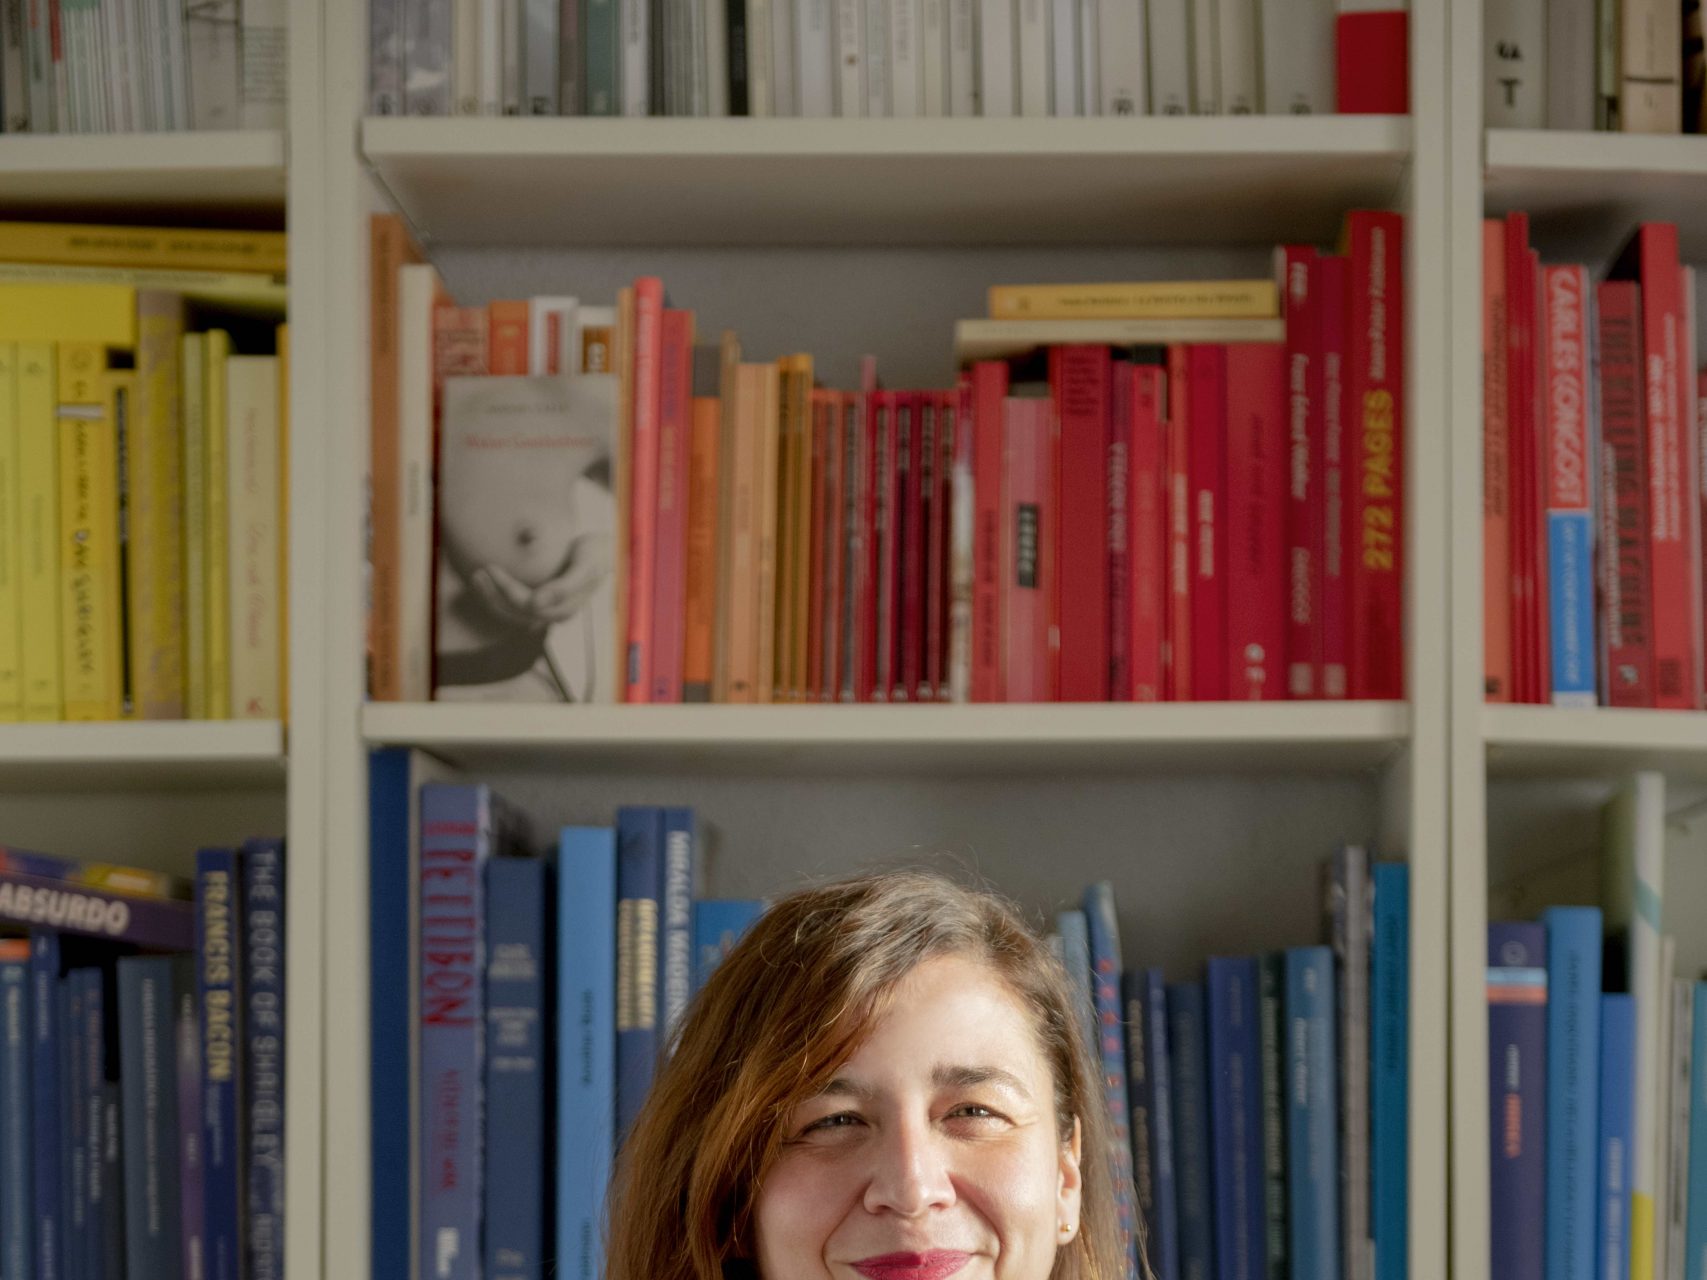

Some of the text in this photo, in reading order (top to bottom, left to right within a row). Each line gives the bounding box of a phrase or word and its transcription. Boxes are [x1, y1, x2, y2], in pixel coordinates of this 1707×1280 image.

[1550, 268, 1584, 505] CARLES CONGOST
[1361, 389, 1394, 571] 272 PAGES
[0, 881, 131, 937] ABSURDO
[203, 870, 233, 984] FRANCIS
[663, 829, 692, 928] MIRALDA
[205, 988, 234, 1083] BACON
[248, 848, 280, 1167] THE BOOK OF SHRIGLEY
